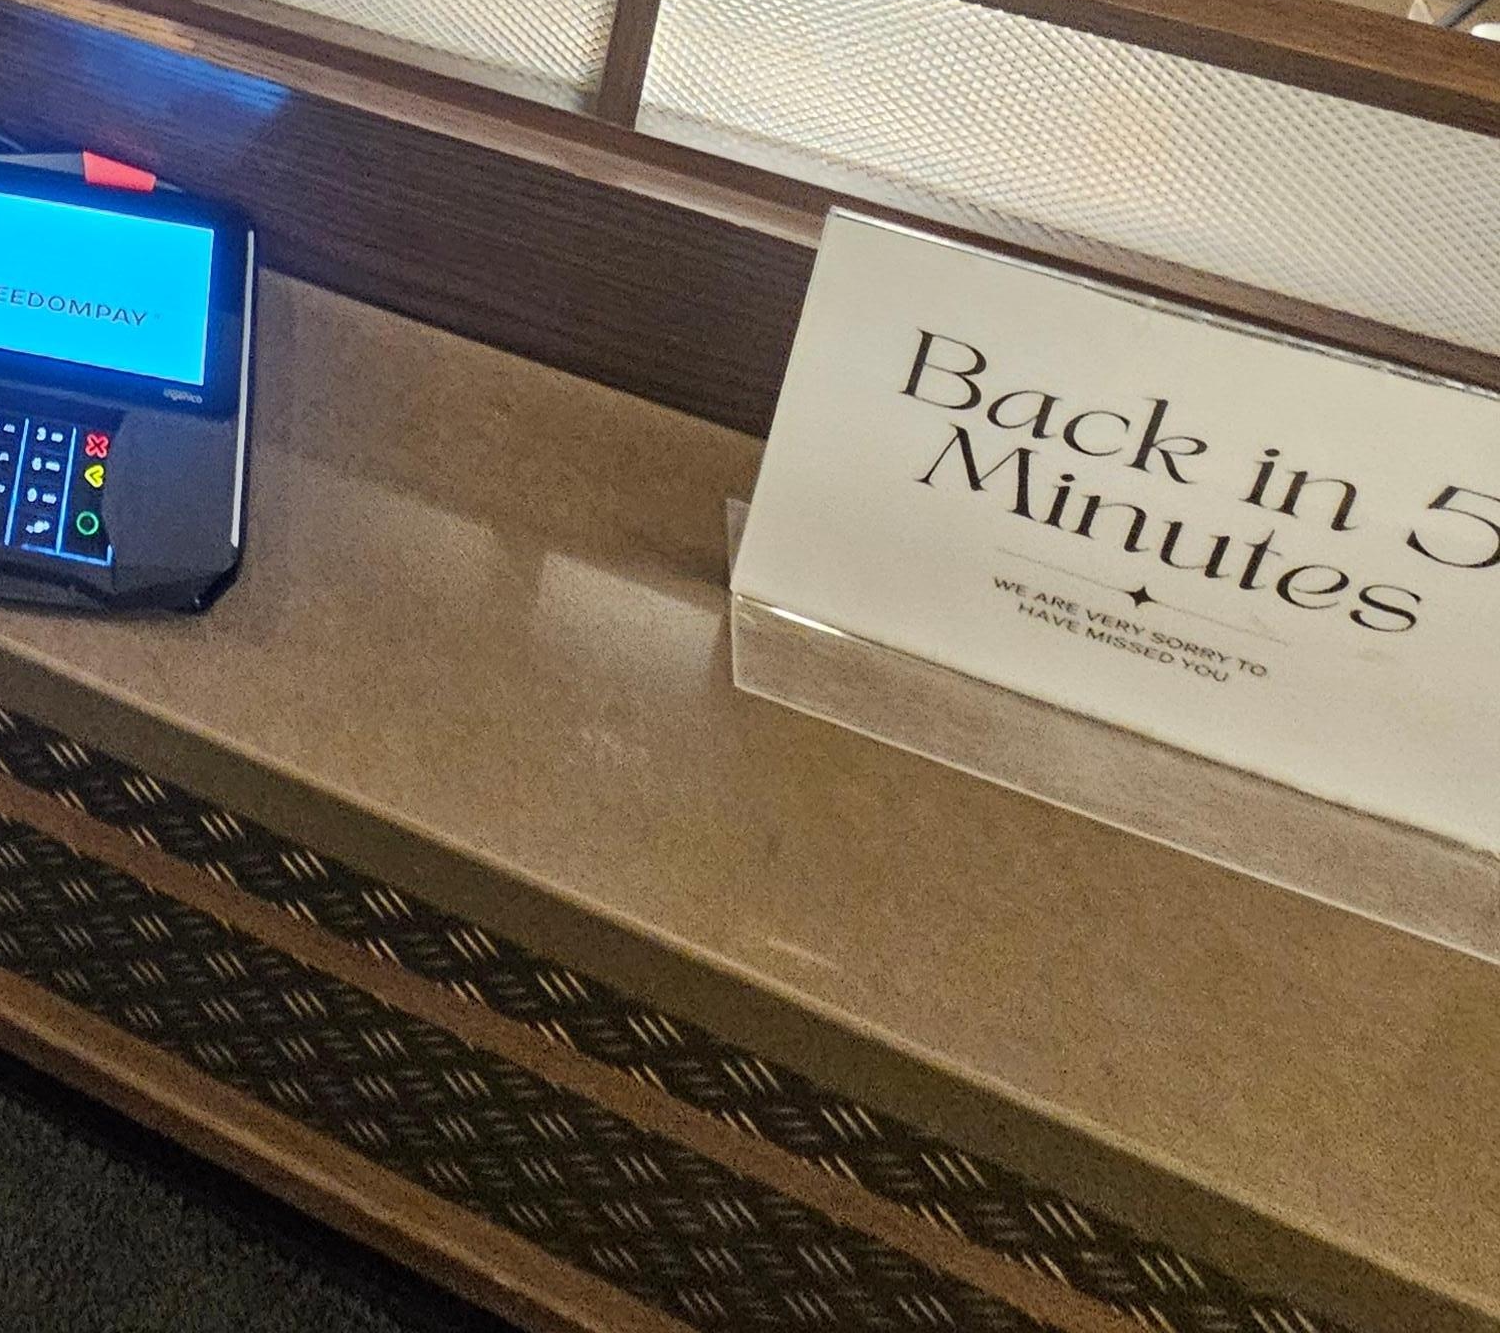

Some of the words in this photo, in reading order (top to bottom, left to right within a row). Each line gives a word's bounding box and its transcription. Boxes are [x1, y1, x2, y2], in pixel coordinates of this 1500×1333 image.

[899, 328, 1208, 484] Back
[1239, 448, 1361, 532] in
[1406, 485, 1500, 569] 5
[917, 422, 1423, 633] Minutes
[993, 576, 1030, 598] WE
[1034, 591, 1081, 616] ARE
[1085, 608, 1147, 635] VERY
[1150, 631, 1232, 664] SORRY
[1236, 656, 1269, 679] TO
[1016, 601, 1081, 634] HAVE
[1085, 627, 1176, 665] MISSED
[1181, 656, 1230, 683] YOU
